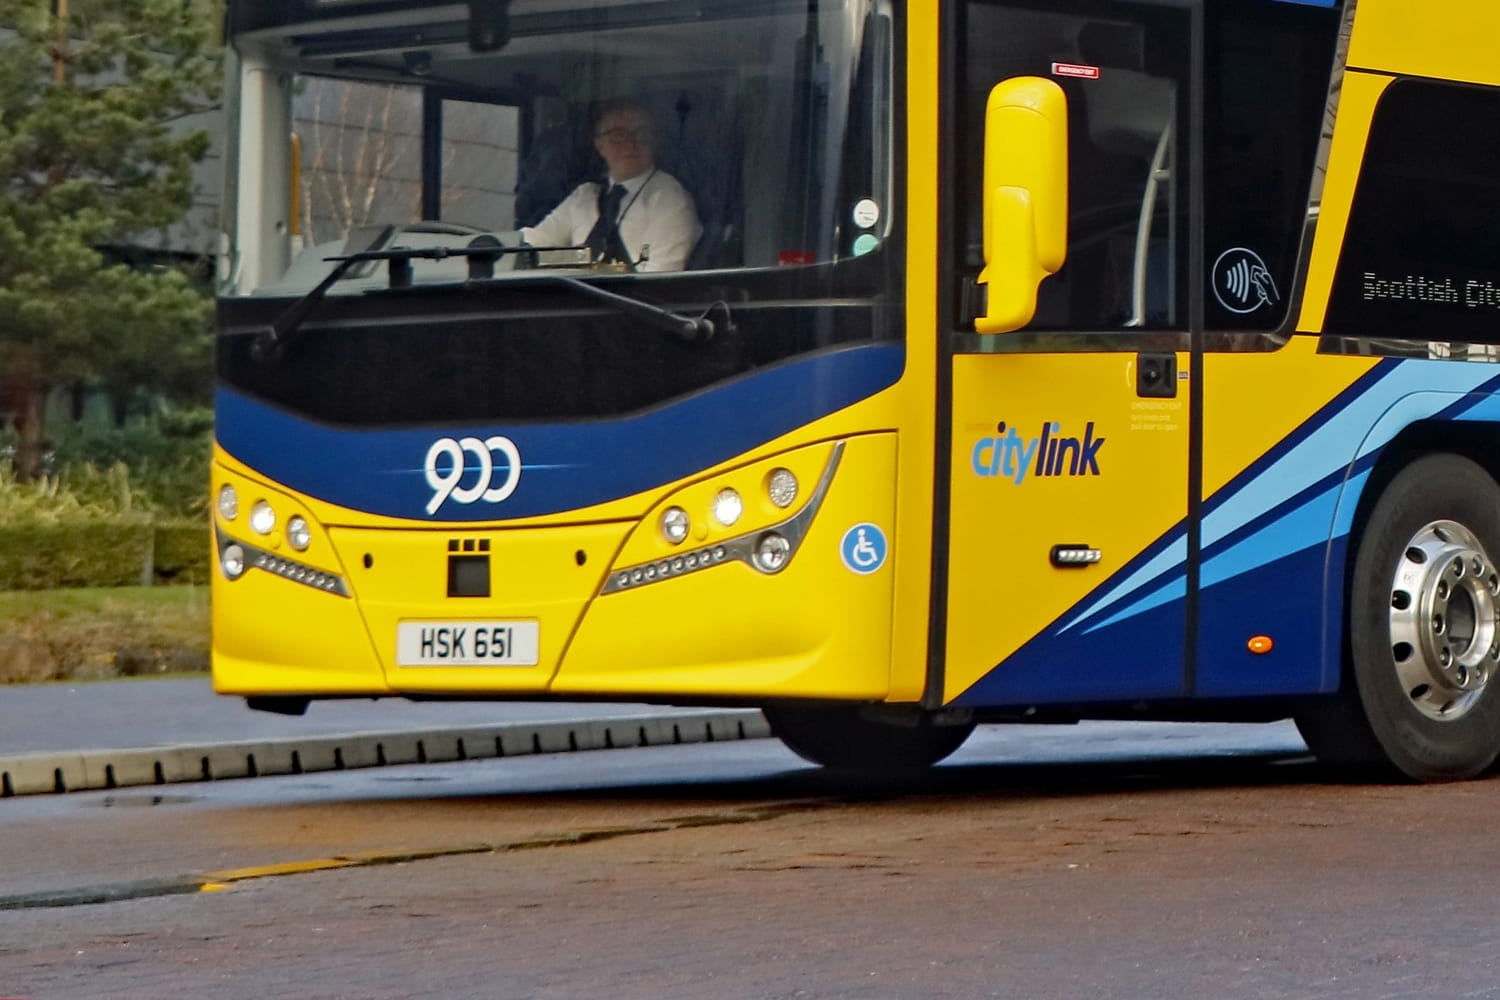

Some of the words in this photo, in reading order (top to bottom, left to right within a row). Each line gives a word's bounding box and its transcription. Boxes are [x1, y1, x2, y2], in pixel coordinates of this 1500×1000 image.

[1364, 272, 1459, 302] Scottish
[424, 437, 521, 516] 900
[971, 421, 1105, 486] citylink
[420, 627, 466, 658] HSK
[474, 627, 513, 658] 651
